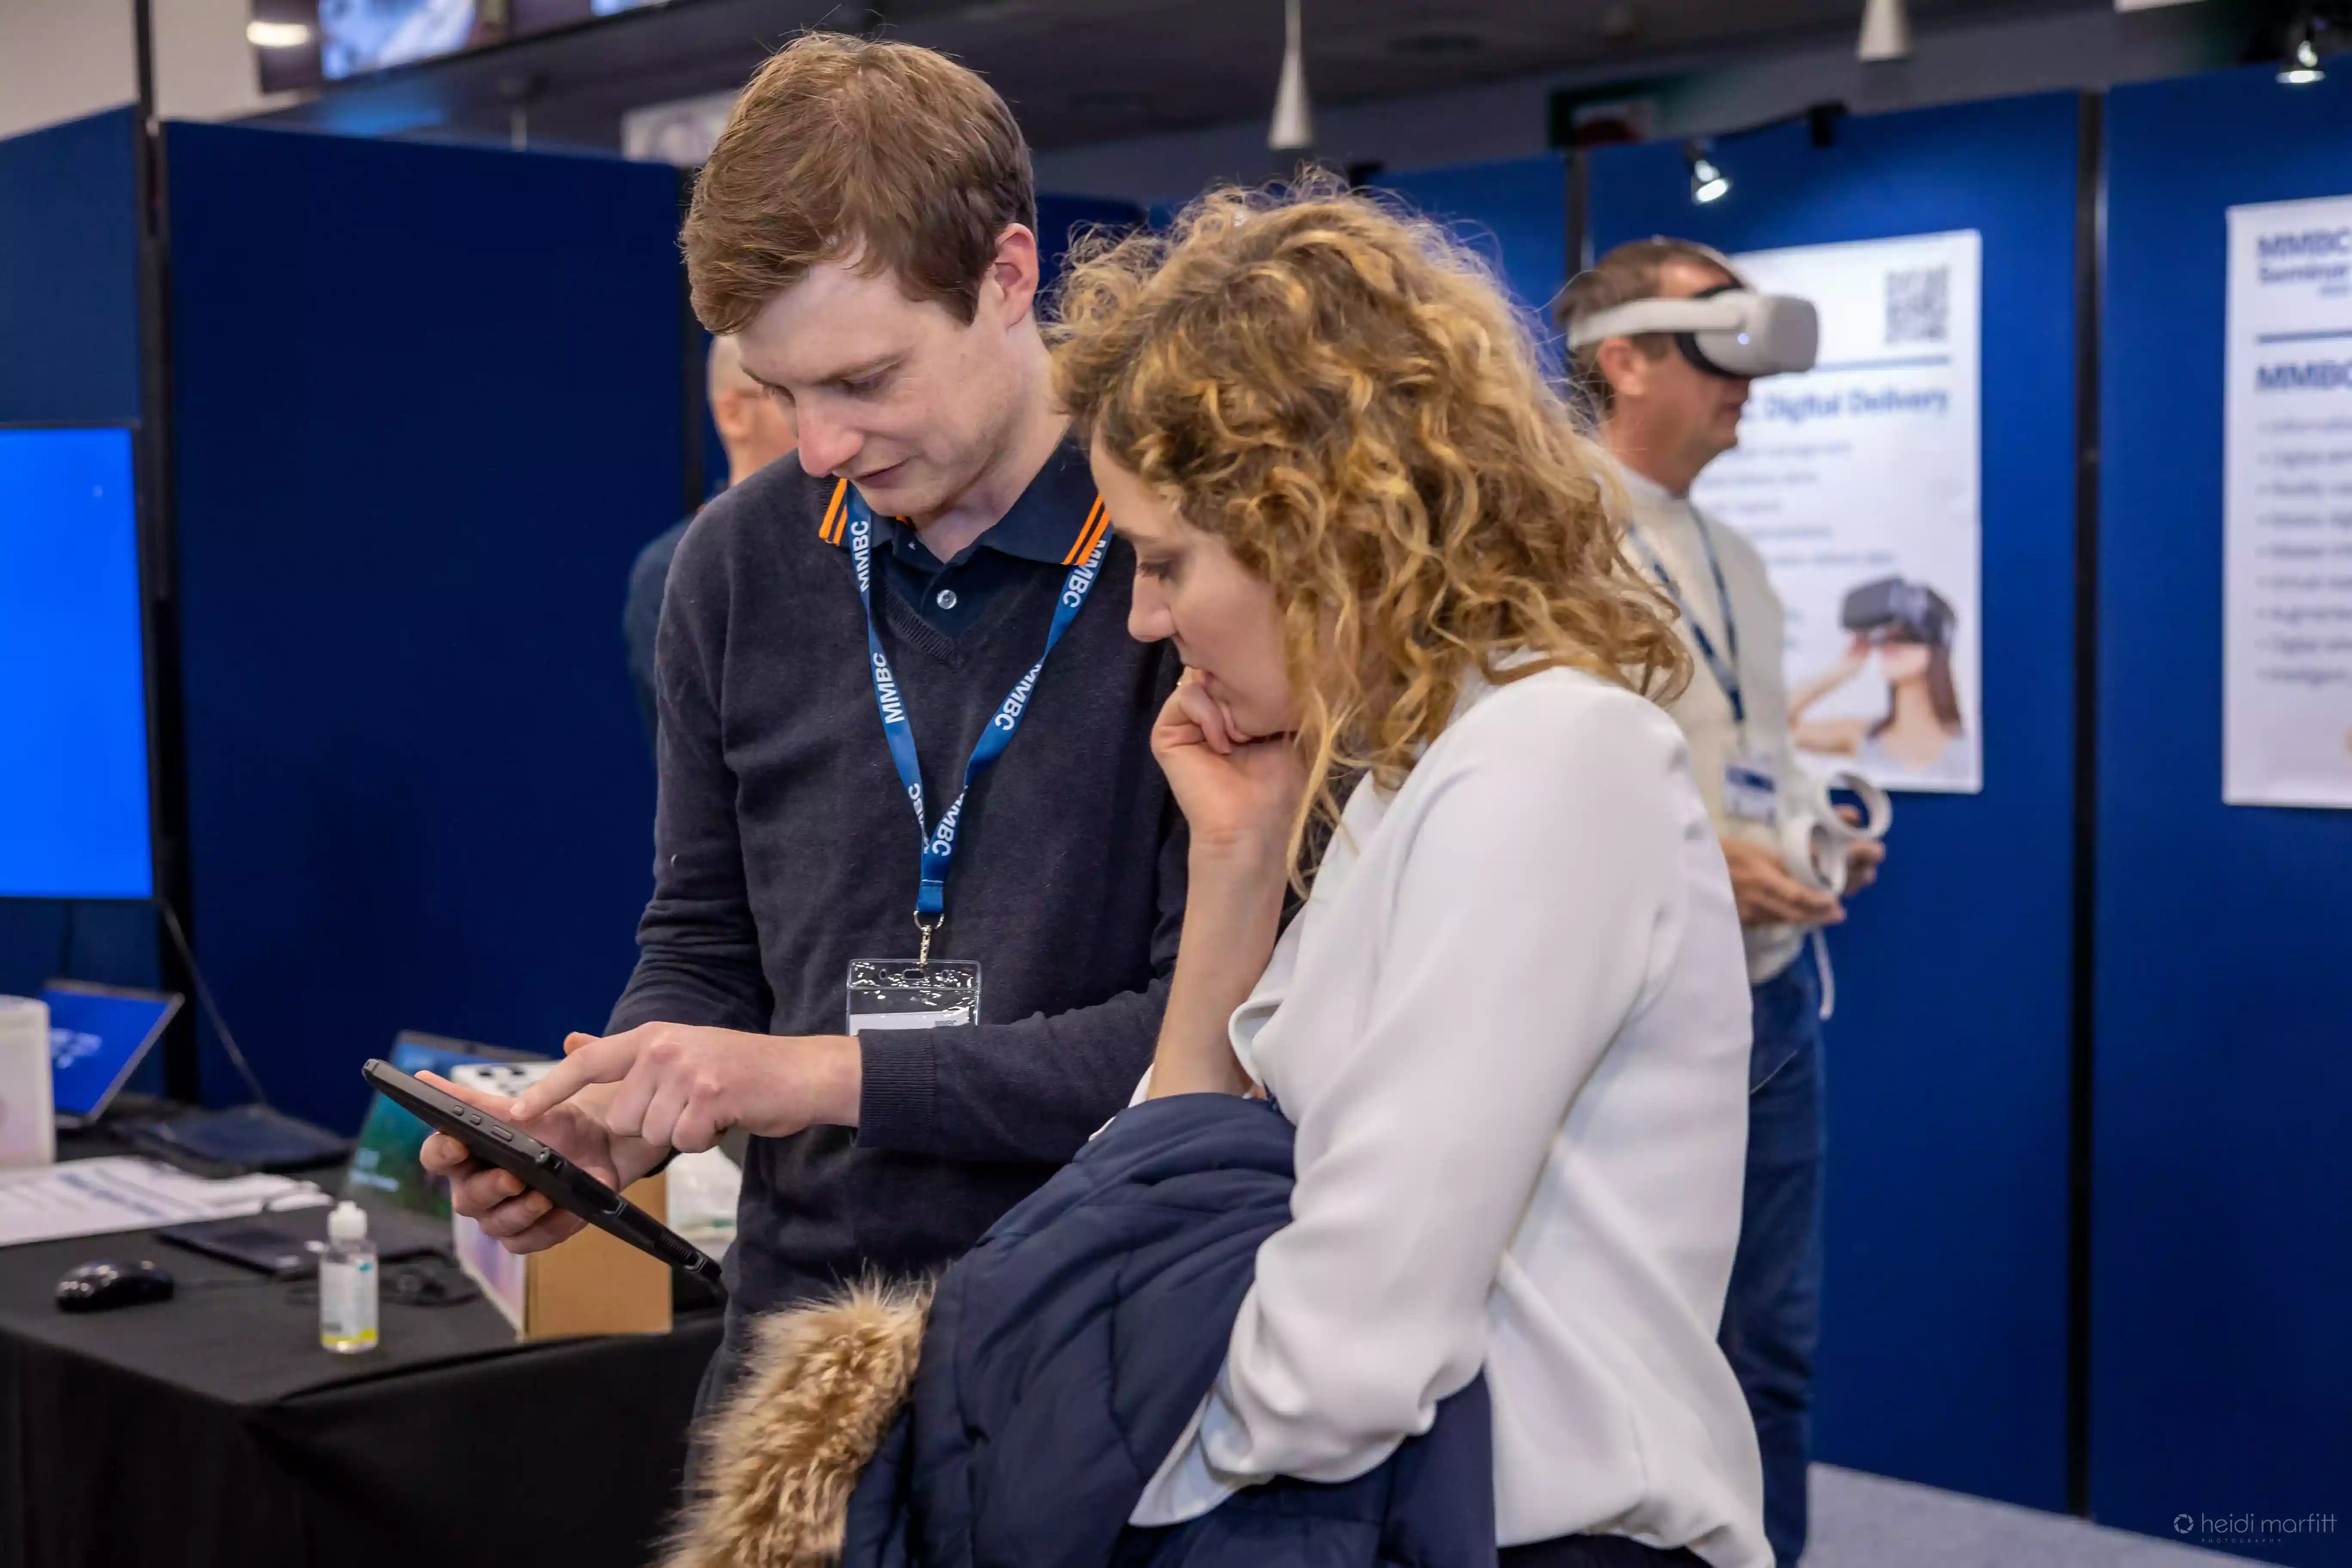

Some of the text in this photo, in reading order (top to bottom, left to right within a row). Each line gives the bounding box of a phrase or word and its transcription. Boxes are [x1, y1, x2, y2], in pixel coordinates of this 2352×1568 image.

[1765, 390, 1839, 422] Digital
[1849, 386, 1948, 415] Delivery
[851, 521, 870, 592] MMBC
[873, 652, 905, 723] MMBC
[994, 664, 1042, 730] MMBC
